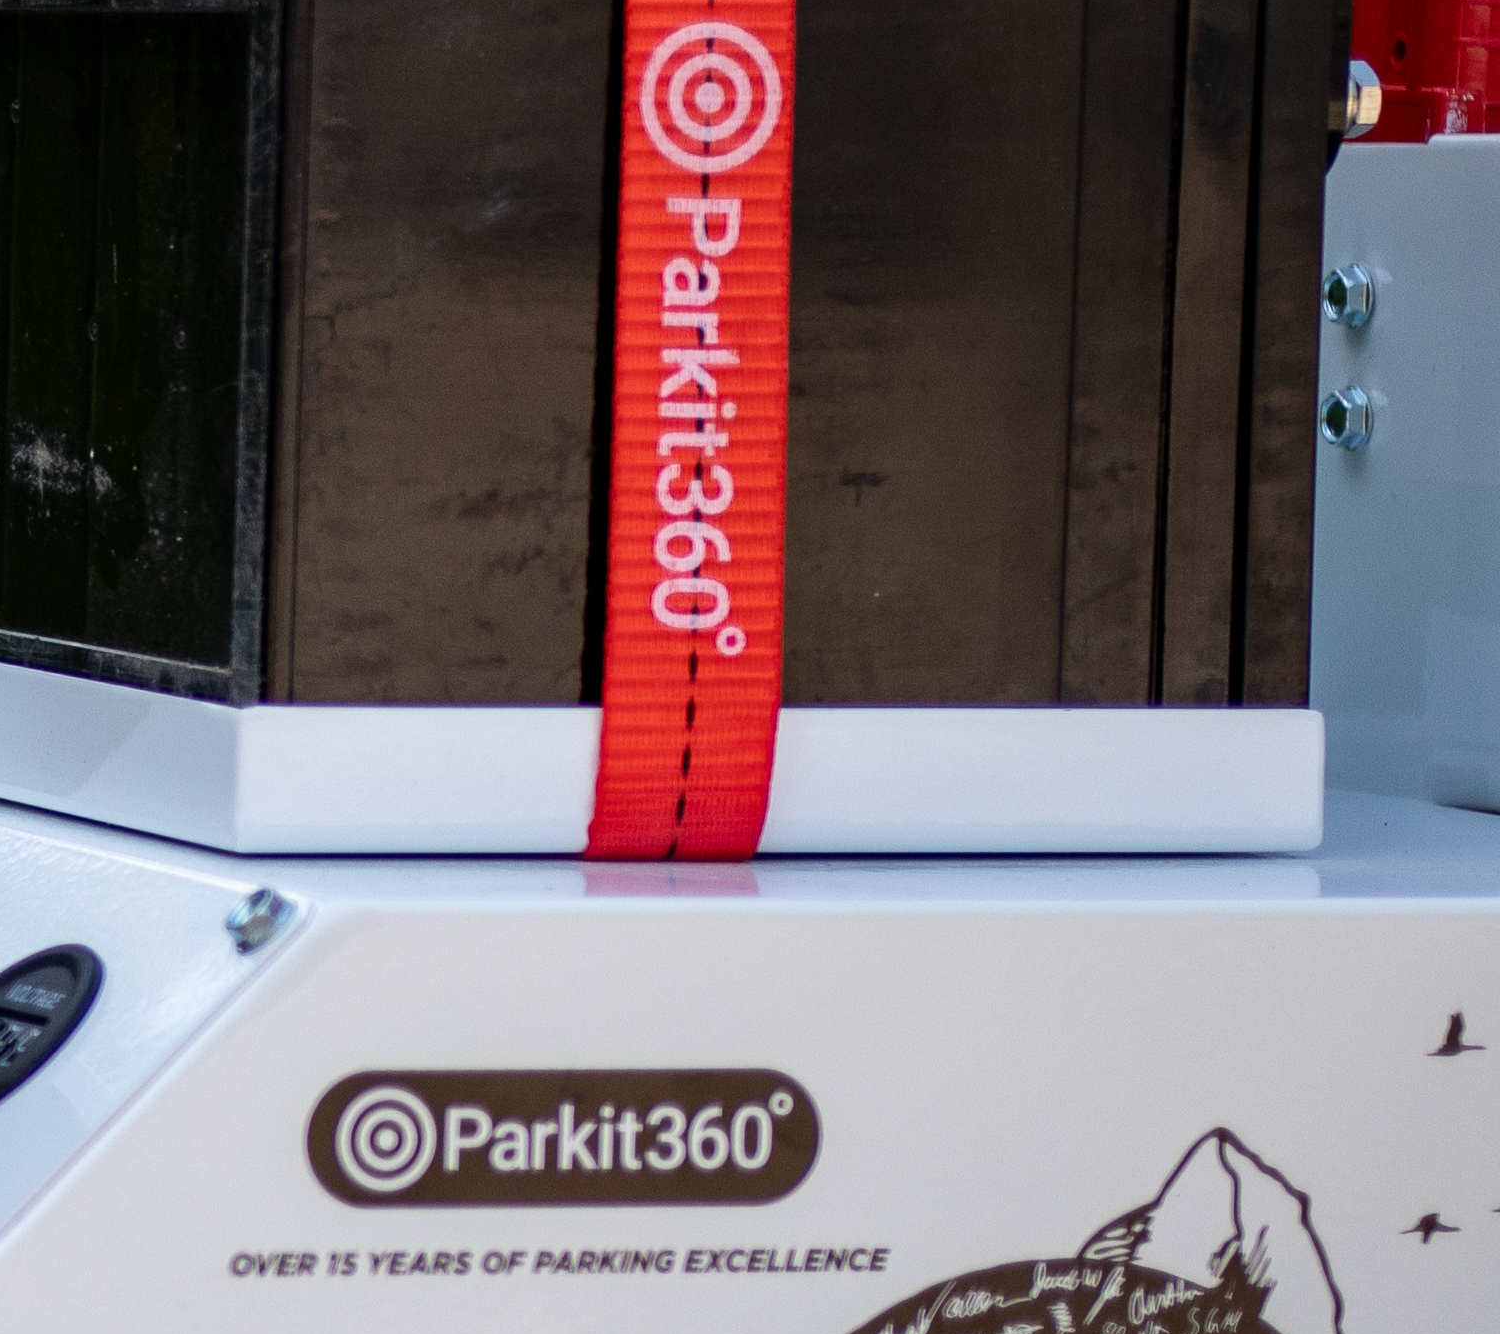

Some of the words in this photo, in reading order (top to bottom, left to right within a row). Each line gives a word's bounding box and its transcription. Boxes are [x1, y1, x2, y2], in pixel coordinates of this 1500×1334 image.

[230, 1252, 319, 1278] OVER
[328, 1253, 358, 1276] 15
[368, 1251, 475, 1276] YEARS
[483, 1251, 527, 1275] OF
[534, 1249, 676, 1275] PARKING
[683, 1247, 890, 1274] EXCELLENCE
